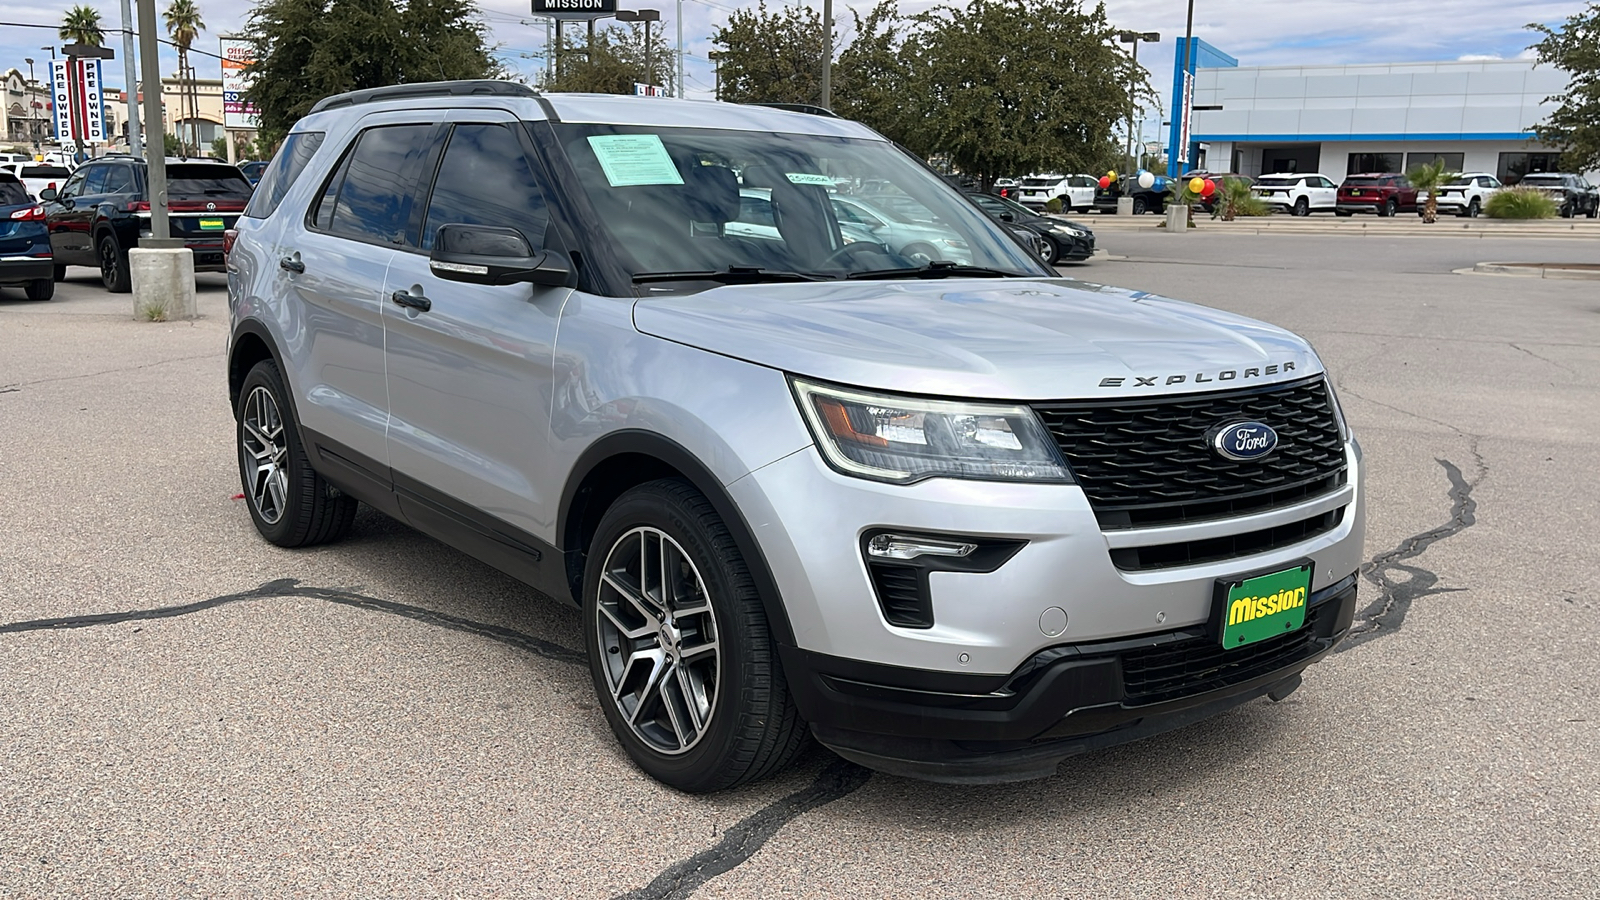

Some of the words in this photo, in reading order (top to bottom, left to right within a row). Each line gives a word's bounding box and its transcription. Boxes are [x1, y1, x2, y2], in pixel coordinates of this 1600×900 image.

[545, 0, 603, 8] MISSION
[55, 65, 64, 88] PRE
[86, 63, 95, 87] PRE
[58, 94, 69, 137] OWNED
[88, 93, 100, 137] OWNED
[63, 145, 76, 154] 40
[1098, 361, 1296, 388] EXPLORER
[1235, 428, 1269, 451] Ford
[1229, 586, 1305, 626] Mission
